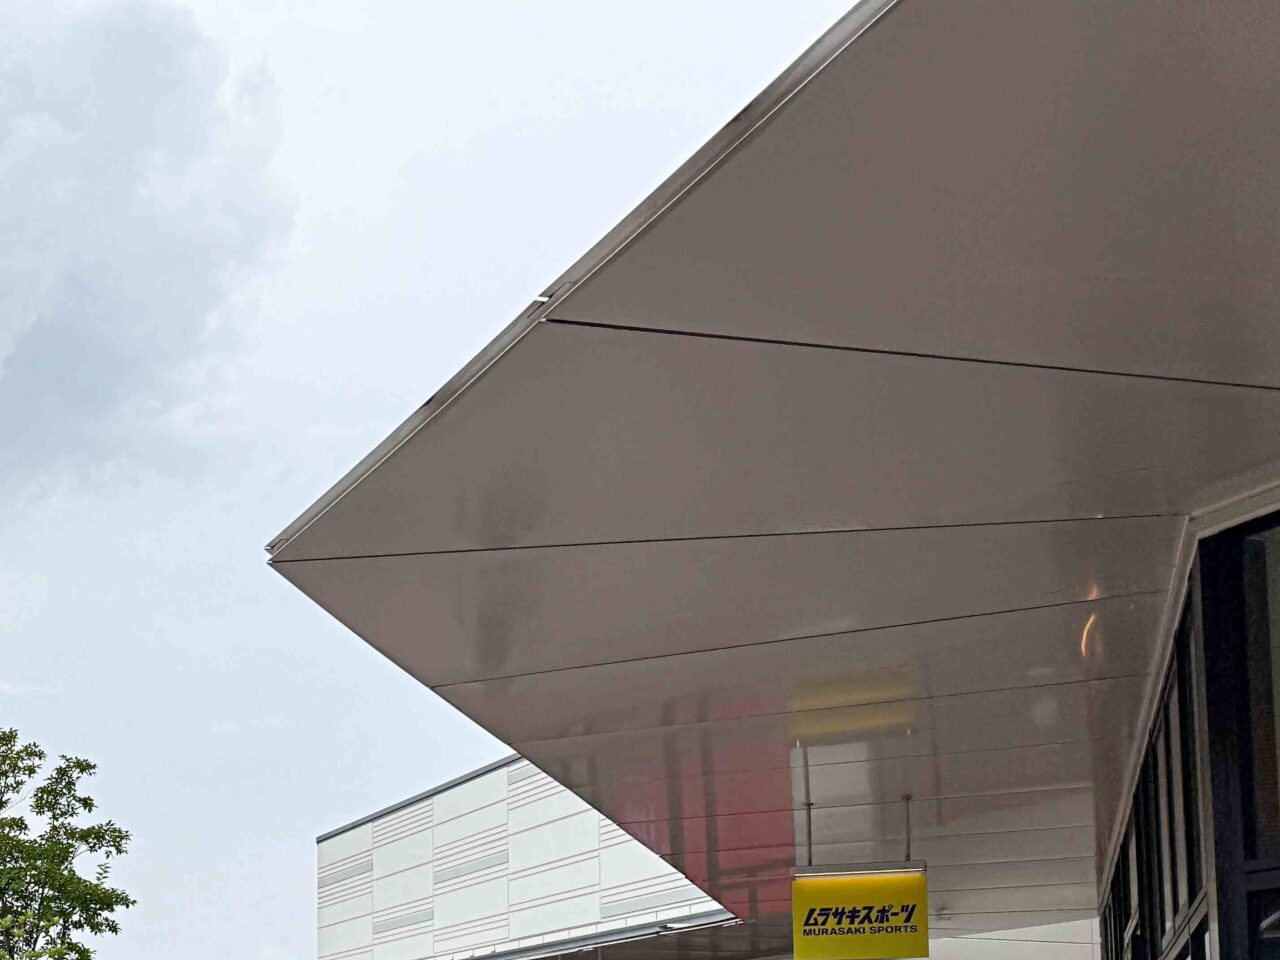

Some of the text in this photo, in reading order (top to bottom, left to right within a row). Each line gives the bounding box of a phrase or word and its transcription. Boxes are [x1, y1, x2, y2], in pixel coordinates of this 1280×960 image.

[803, 904, 917, 927] ムラサキスポーツ
[803, 925, 918, 937] MURASAKI SPORTS
